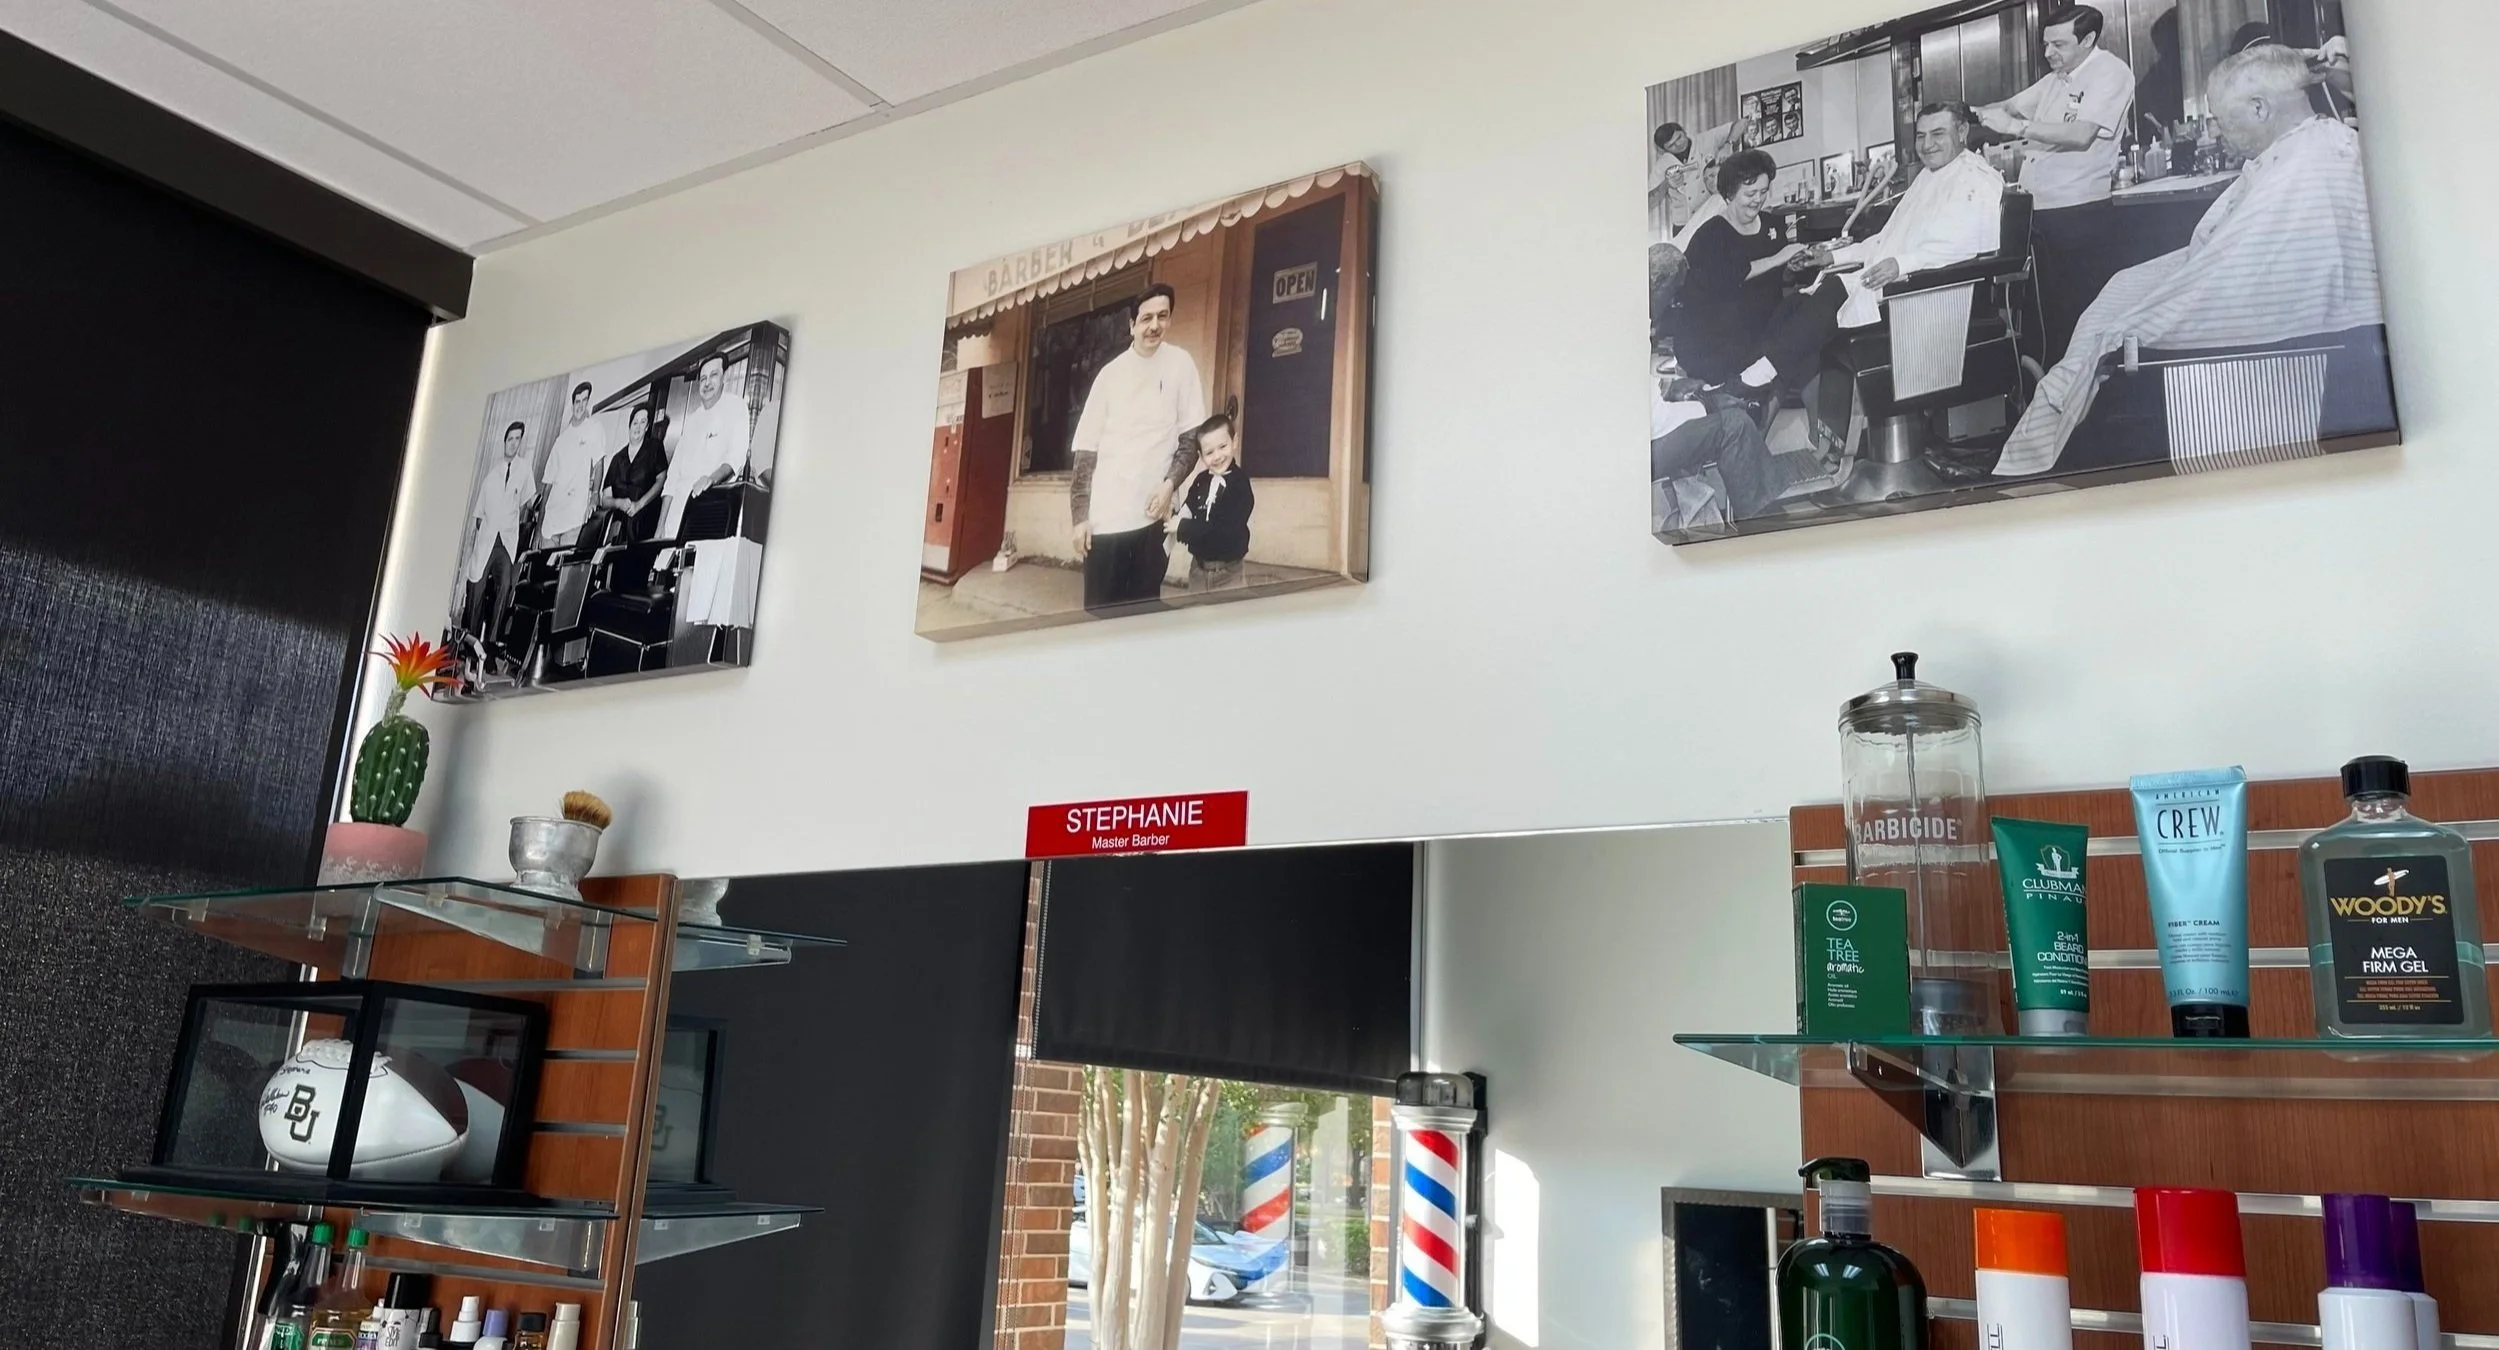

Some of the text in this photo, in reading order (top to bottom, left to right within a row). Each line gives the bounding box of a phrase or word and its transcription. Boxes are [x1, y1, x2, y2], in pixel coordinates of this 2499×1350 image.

[1276, 270, 1315, 297] OPEN
[2155, 788, 2220, 800] AMERICAN
[1066, 800, 1204, 833] STEPHANIE
[2157, 805, 2220, 839] CREW
[1854, 816, 1958, 842] BARBICIDE
[1092, 834, 1170, 849] Master Barber
[2026, 893, 2084, 904] PINAU
[2331, 895, 2445, 917] WOODY'S
[2390, 916, 2409, 924] MEN
[2057, 931, 2079, 942] 2-in-1
[1826, 937, 1854, 950] TEA
[2053, 941, 2085, 955] BEARD
[1827, 949, 1860, 963] TREE
[2371, 946, 2418, 959] MEGA
[1826, 962, 1865, 974] aromatic
[2362, 961, 2429, 974] FIRM GEL
[2204, 987, 2219, 995] 100
[284, 1084, 320, 1143] BU
